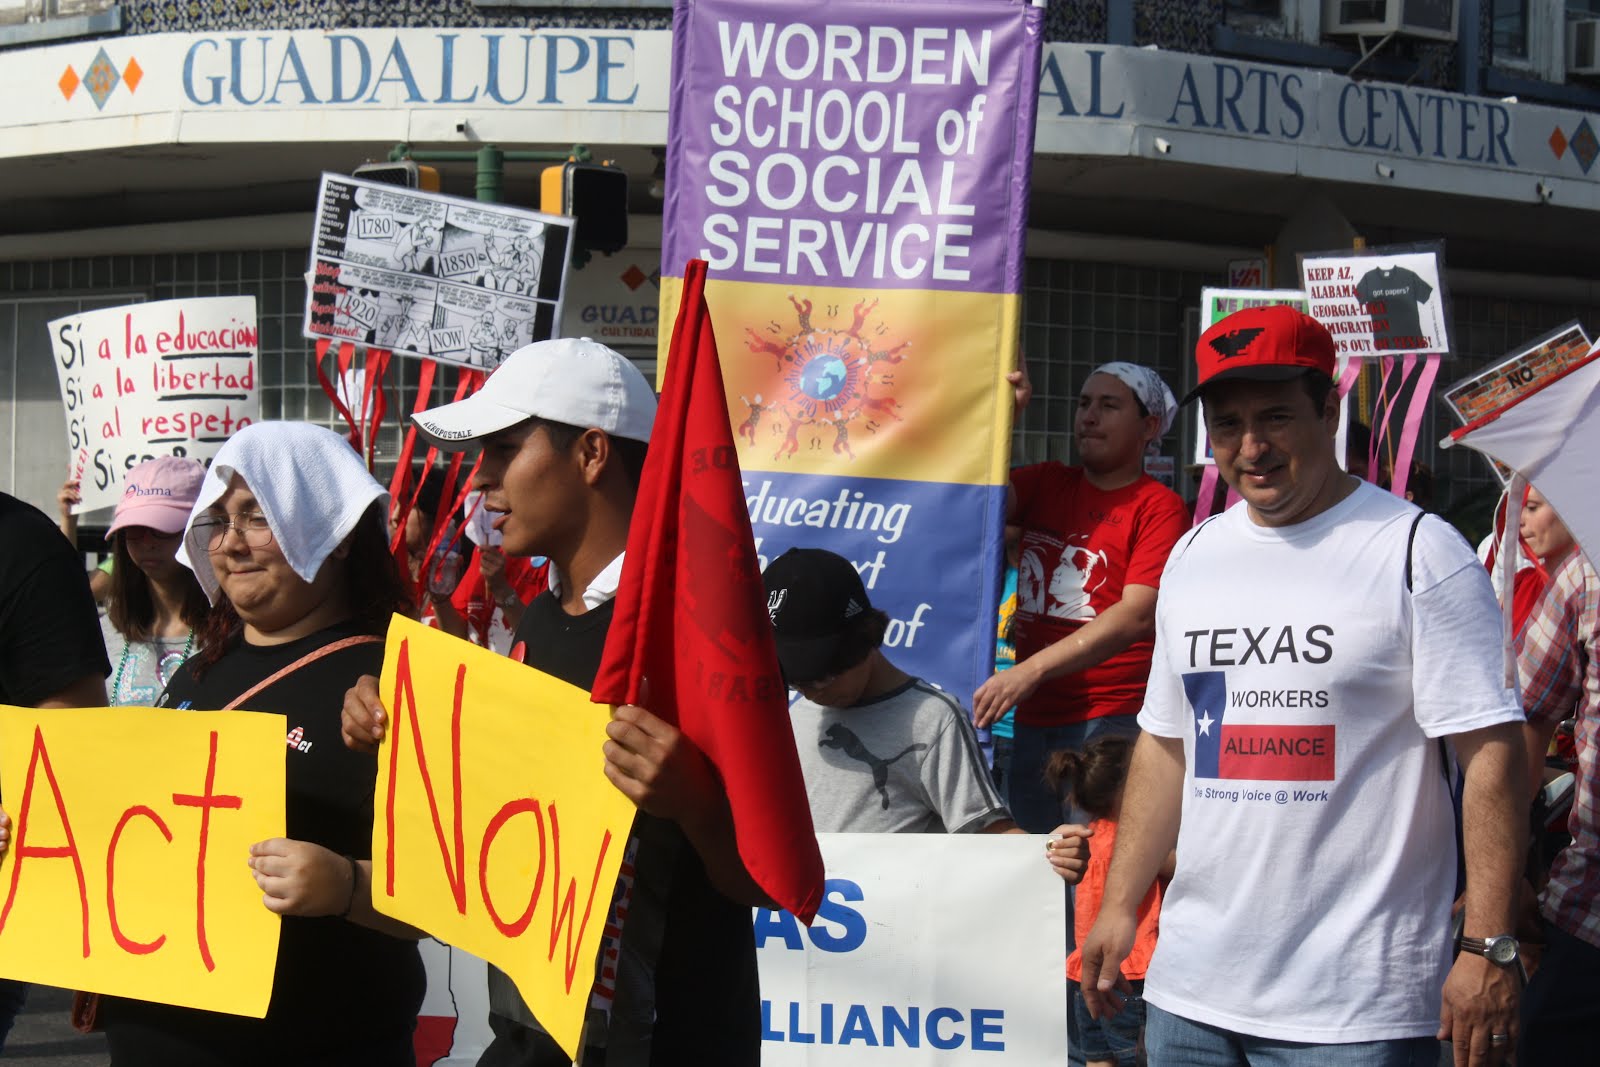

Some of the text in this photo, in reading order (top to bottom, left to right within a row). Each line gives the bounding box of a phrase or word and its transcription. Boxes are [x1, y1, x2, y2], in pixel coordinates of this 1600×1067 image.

[182, 34, 640, 106] GUADALUPE
[718, 21, 992, 86] WORDEN
[710, 85, 987, 156] SCHOOL of
[1167, 63, 1304, 139] ARTS
[1337, 82, 1518, 166] CENTER
[705, 150, 976, 217] SOCIAL
[361, 217, 391, 235] 1780
[443, 252, 475, 273] 1850
[700, 213, 973, 281] SERVICE
[1307, 266, 1354, 282] KEEP AZ,
[1372, 286, 1410, 297] got papers?
[343, 294, 376, 325] 1920
[98, 338, 111, 360] a
[126, 313, 148, 360] la
[433, 329, 463, 349] NOW
[1350, 339, 1371, 352] OUT
[92, 383, 103, 399] a
[116, 367, 136, 398] la
[153, 360, 254, 392] libertad
[1506, 366, 1534, 390] NO
[102, 405, 121, 439] al
[743, 480, 912, 544] ducating
[883, 603, 933, 648] of
[1184, 624, 1335, 668] TEXAS
[1232, 690, 1329, 708] WORKERS
[1224, 737, 1326, 757] ALLIANCE
[1205, 787, 1239, 802] Strong
[1242, 788, 1272, 802] Voice
[1274, 790, 1289, 805] @
[1293, 790, 1329, 803] Work
[761, 1000, 1005, 1052] LLIANCE
